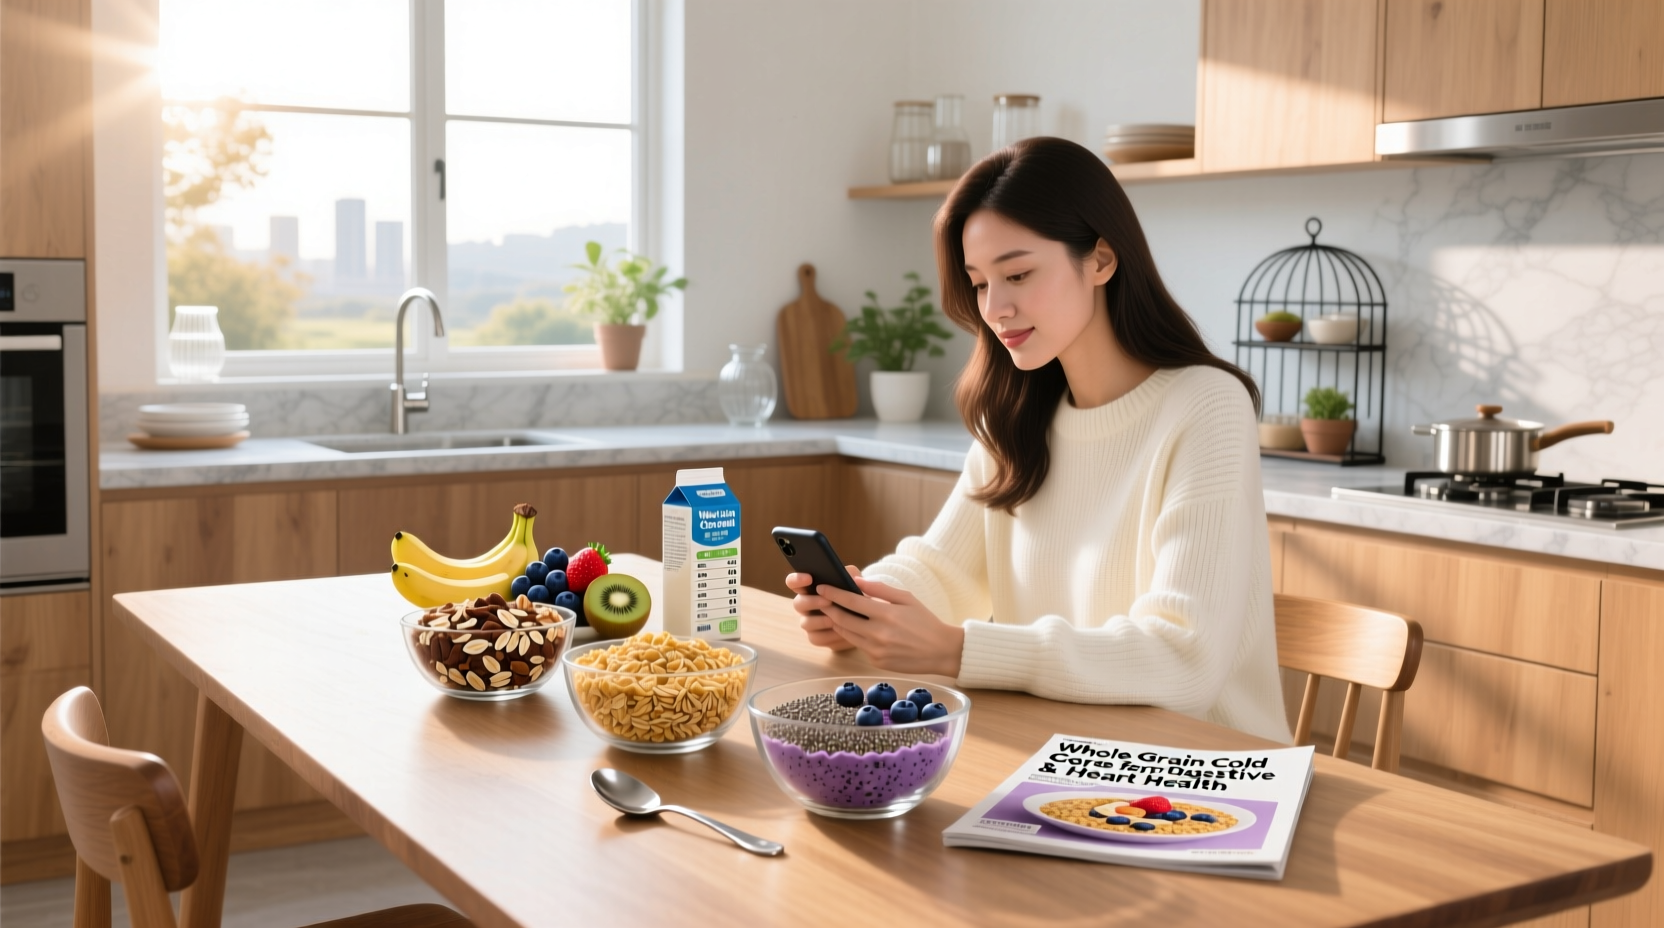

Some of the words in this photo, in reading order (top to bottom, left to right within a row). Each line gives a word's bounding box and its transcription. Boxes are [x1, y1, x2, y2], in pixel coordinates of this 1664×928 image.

[1059, 742, 1132, 760] Whole
[1137, 752, 1205, 767] Grain
[1211, 757, 1269, 769] Cold
[1065, 766, 1137, 784] Heart
[1143, 774, 1228, 791] Health
